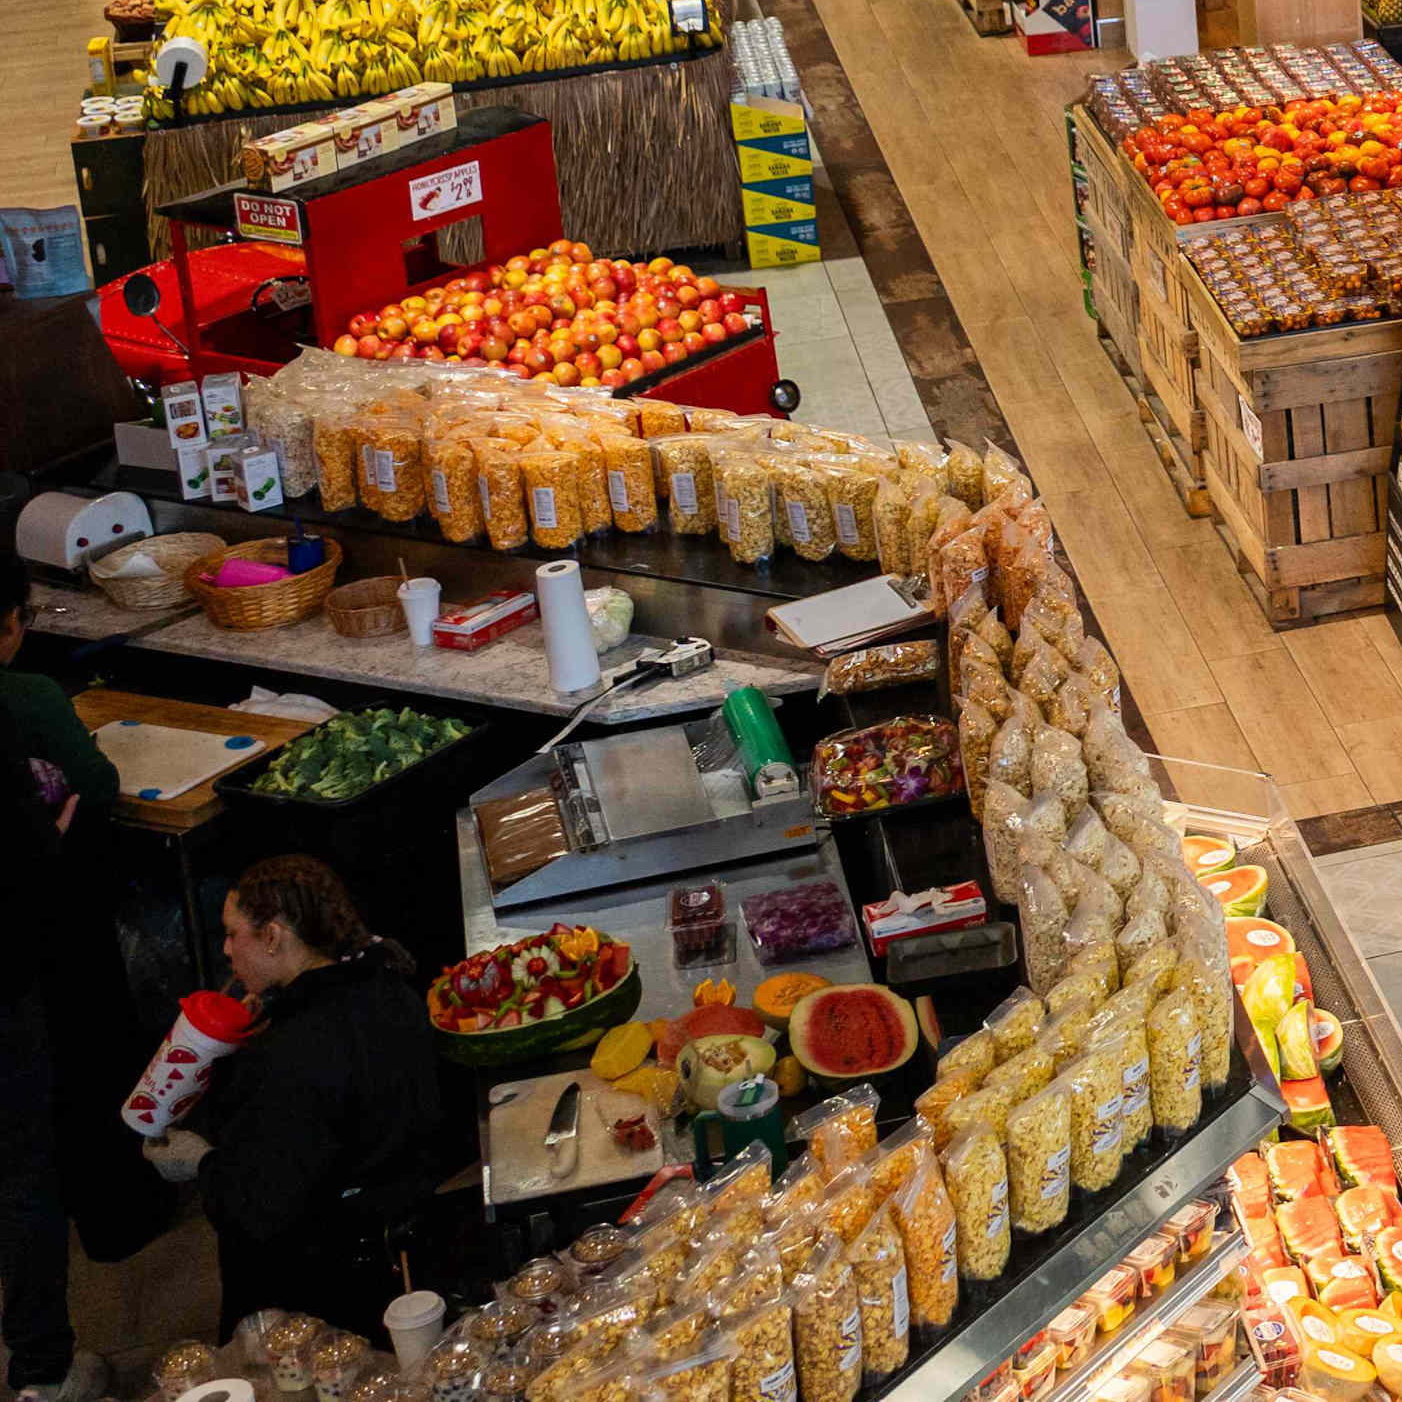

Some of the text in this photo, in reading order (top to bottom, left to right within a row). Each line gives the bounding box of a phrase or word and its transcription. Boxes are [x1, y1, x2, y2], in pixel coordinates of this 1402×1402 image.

[241, 200, 292, 216] DO NOT
[250, 212, 287, 227] OPEN
